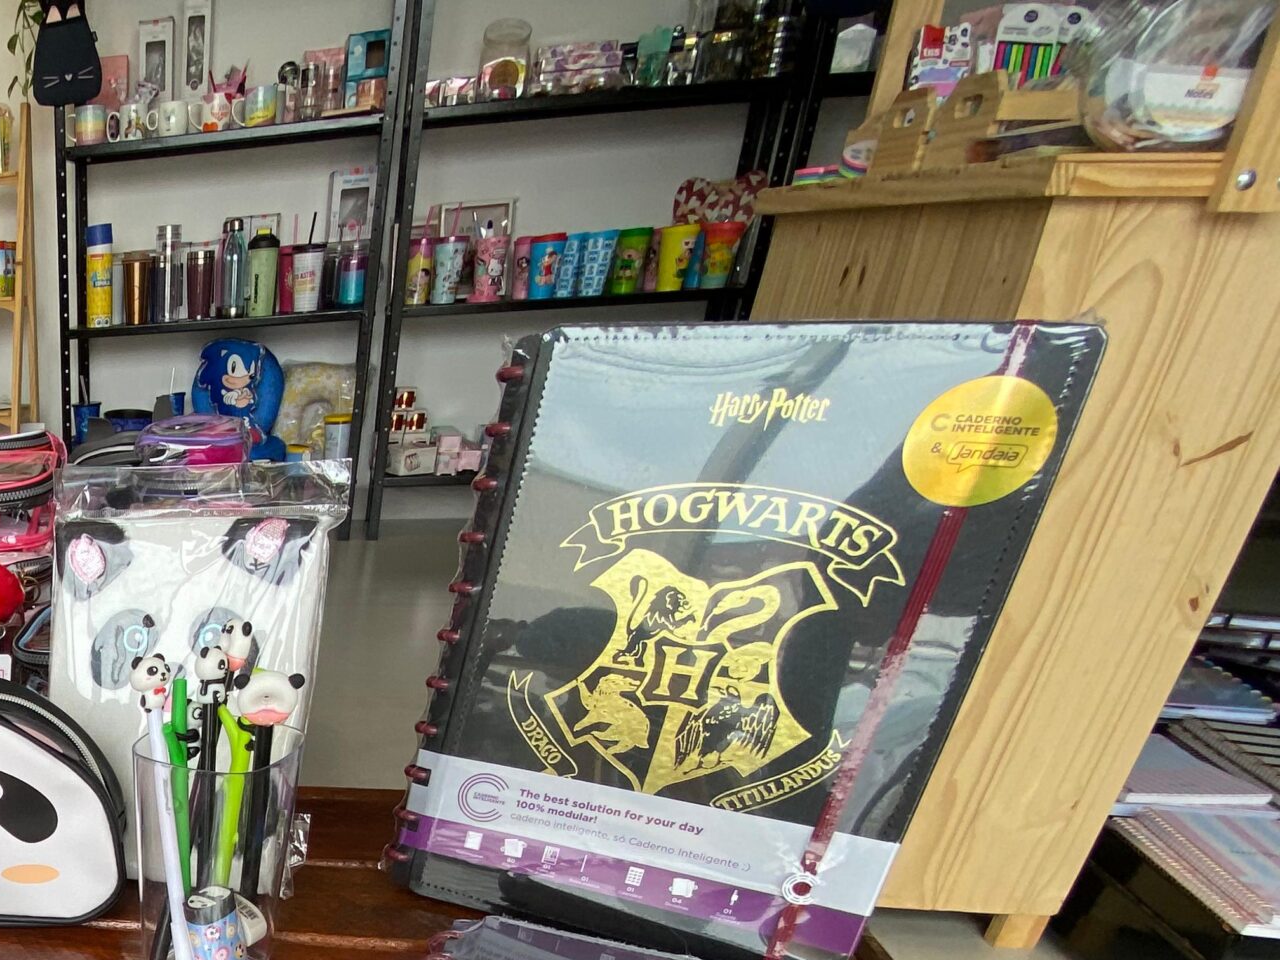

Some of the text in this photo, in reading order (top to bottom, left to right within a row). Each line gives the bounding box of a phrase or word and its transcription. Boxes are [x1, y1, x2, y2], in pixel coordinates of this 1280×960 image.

[709, 387, 830, 431] Harry Potter
[951, 424, 1040, 436] INTELIGENTE
[955, 414, 1023, 425] CADERNO
[931, 442, 1020, 463] & Jandaia
[607, 487, 885, 556] HOGWARTS
[660, 645, 714, 701] H
[521, 718, 561, 765] DRACO
[720, 750, 841, 811] TITILLANDUS
[516, 799, 598, 824] 100% modular!
[520, 788, 704, 836] The best solution for your day
[510, 812, 551, 828] caderno
[613, 832, 626, 843] só
[628, 832, 676, 855] Caderno
[677, 847, 740, 871] Inteligente
